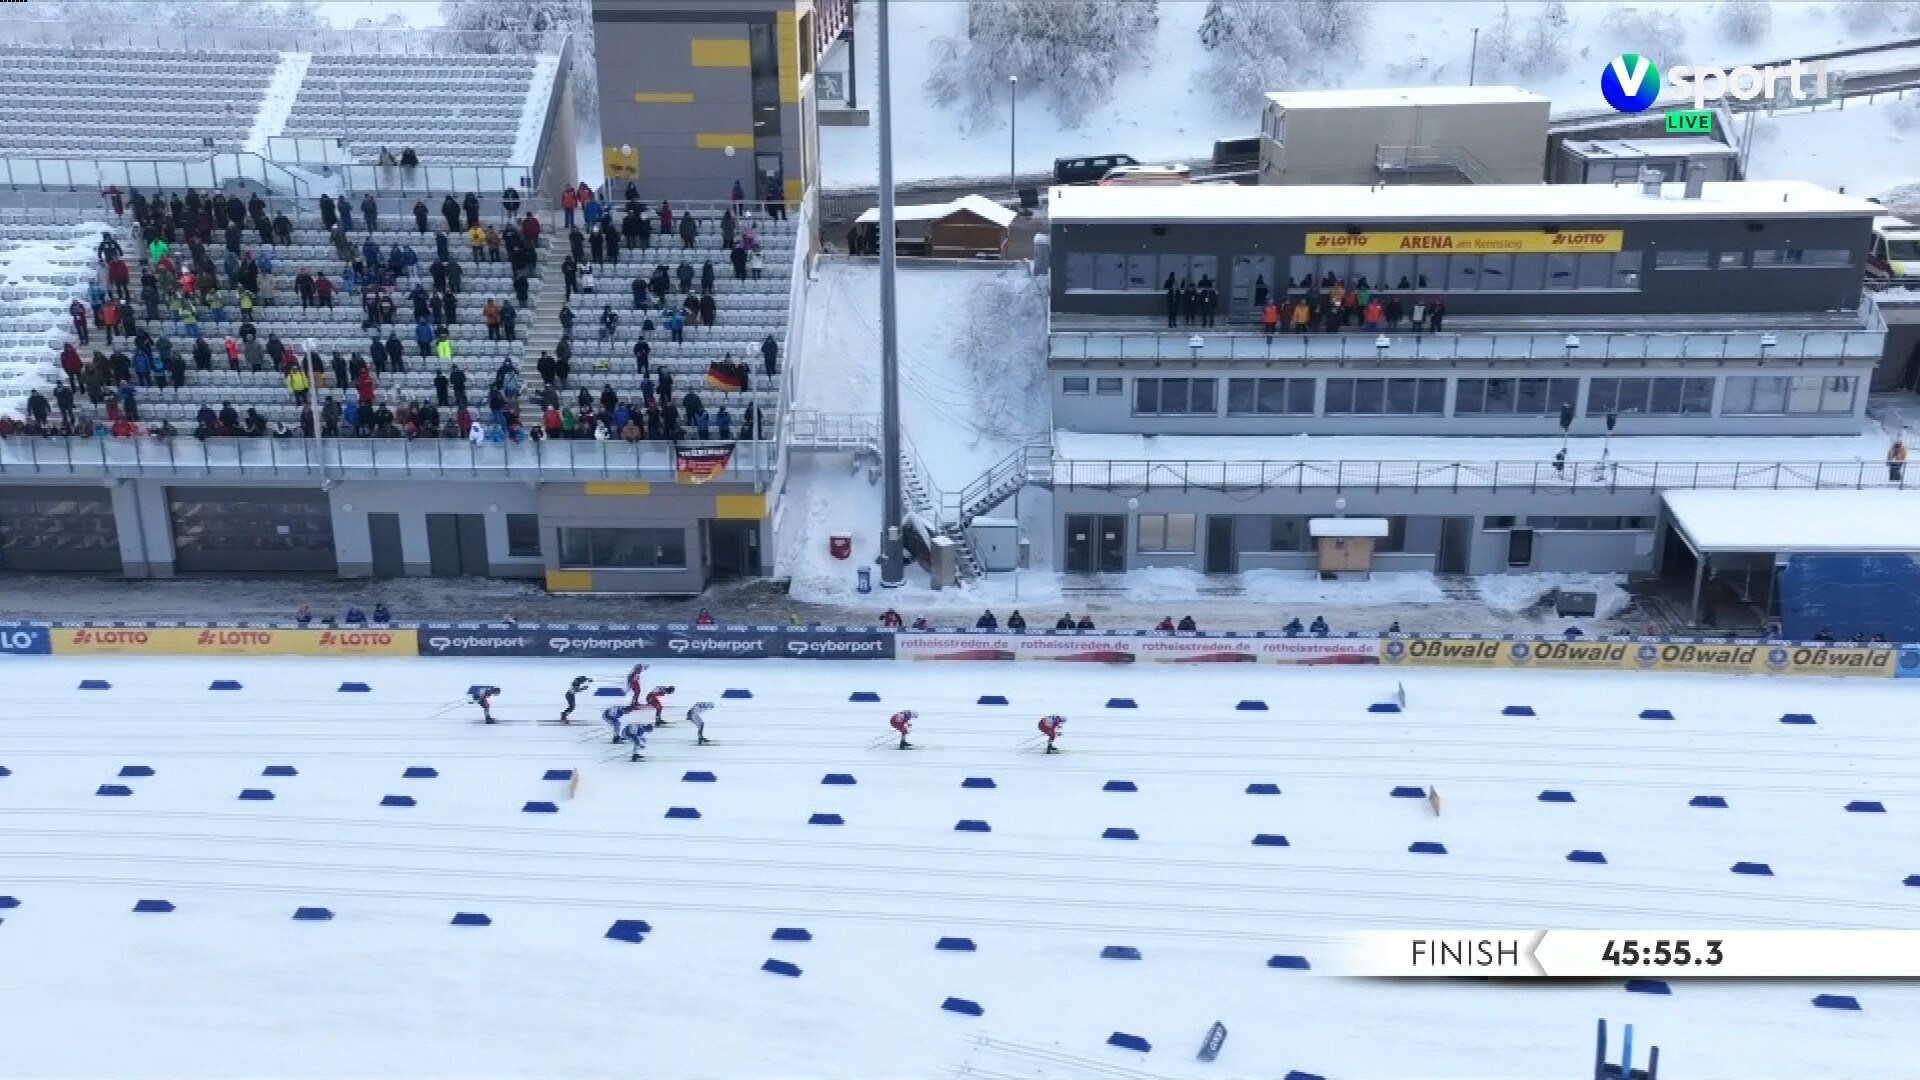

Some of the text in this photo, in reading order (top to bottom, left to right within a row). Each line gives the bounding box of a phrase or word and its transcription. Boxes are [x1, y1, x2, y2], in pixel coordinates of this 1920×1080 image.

[1331, 235, 1368, 247] LOTTO
[1400, 235, 1453, 249] ARENA
[1455, 240, 1472, 249] am
[1567, 233, 1606, 245] LOTTO
[95, 631, 149, 644] LOTTO
[219, 631, 272, 645] LOTTO
[340, 633, 392, 645] LOTTO
[452, 636, 524, 649] cyberport
[572, 637, 644, 651] cyberport
[691, 638, 764, 651] cyberport
[810, 639, 883, 653] cyberport
[1409, 641, 1500, 659] Oßwald
[1534, 643, 1627, 661] Oßwald
[1661, 646, 1757, 664] Oßwald
[1792, 649, 1891, 667] Oßwald
